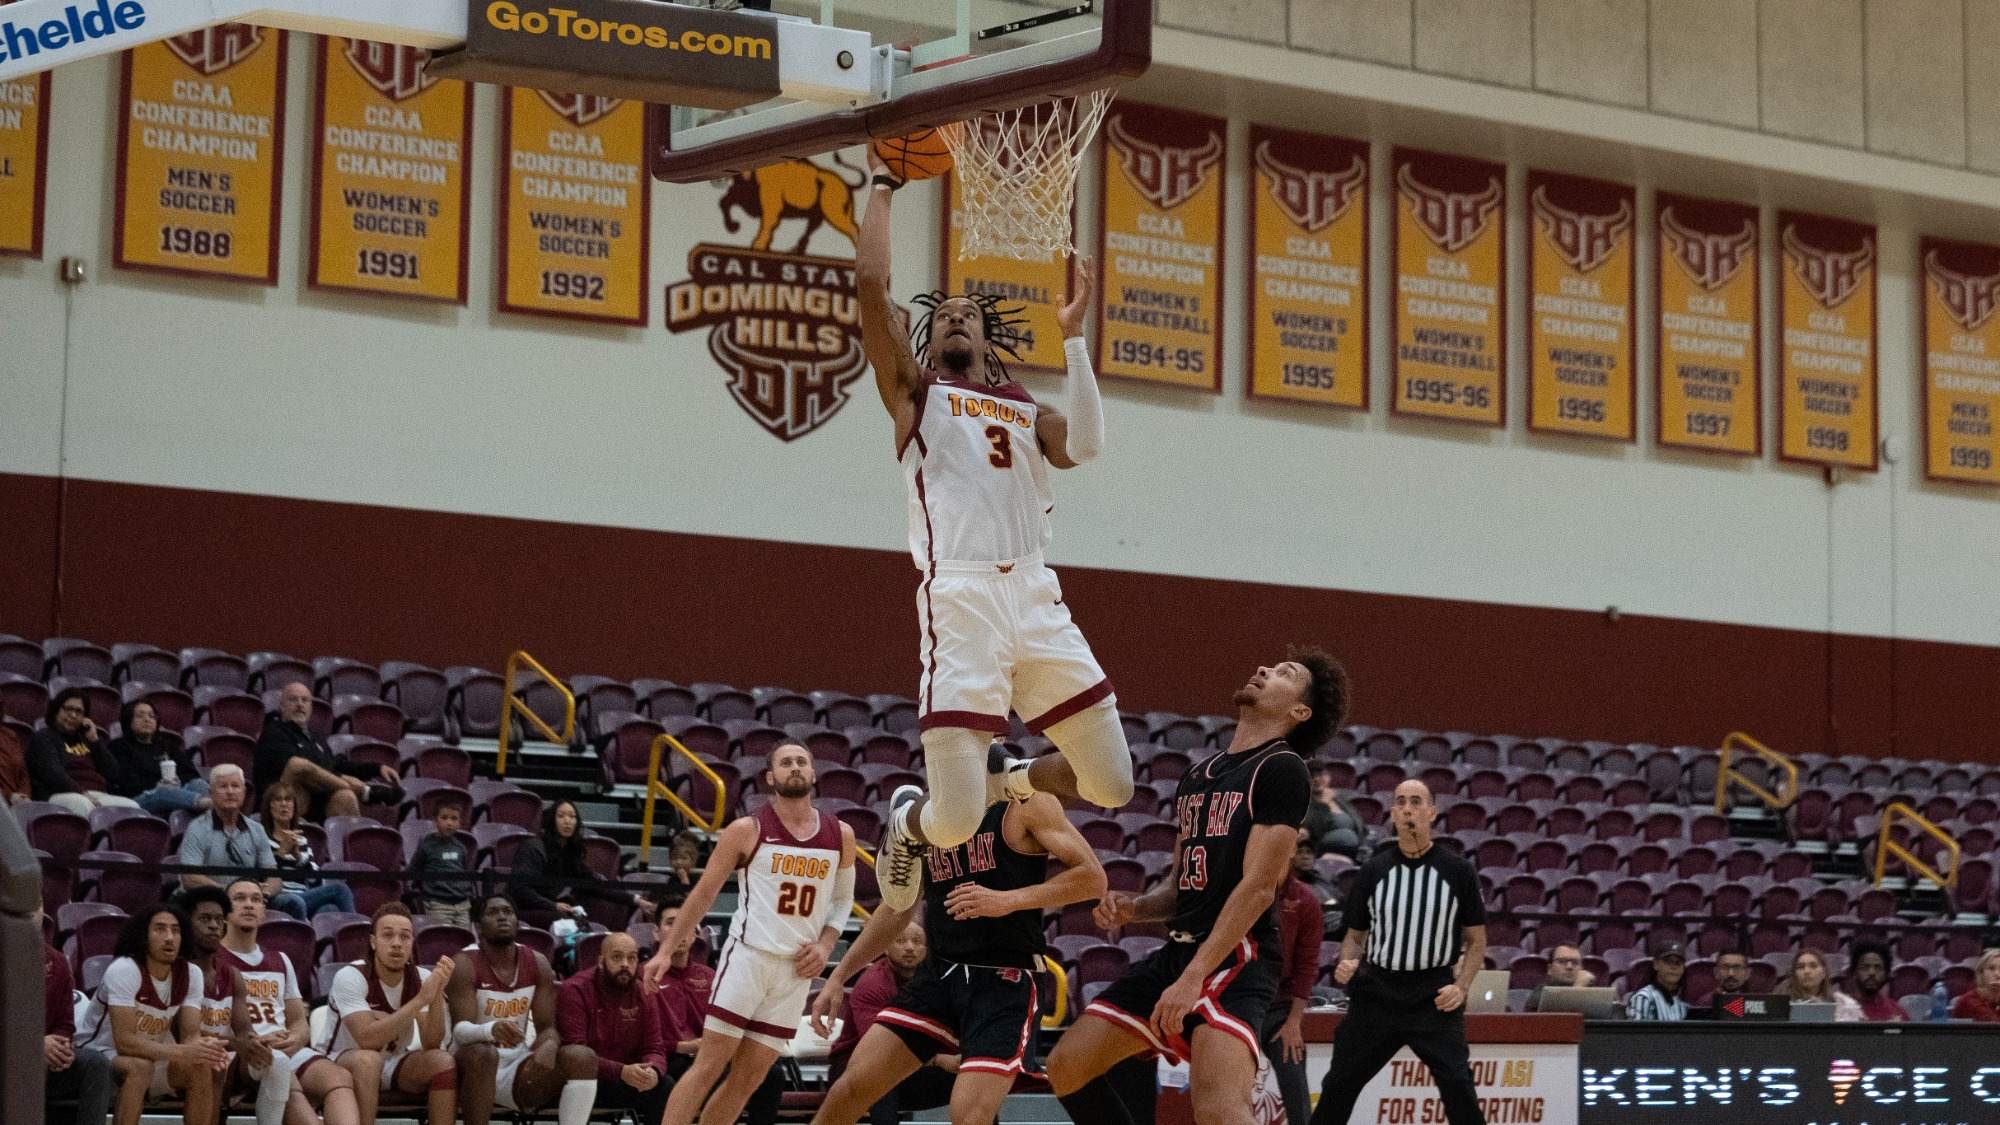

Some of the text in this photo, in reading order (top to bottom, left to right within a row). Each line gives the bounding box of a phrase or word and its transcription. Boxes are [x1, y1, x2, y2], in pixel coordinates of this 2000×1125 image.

[0, 0, 146, 63] helde
[486, 0, 772, 60] GoToros.com
[172, 79, 232, 107] CCAA
[132, 100, 271, 137] CONFERENCE
[365, 104, 422, 130] CCAA
[142, 126, 258, 162] CHAMPION
[325, 125, 458, 162] CONFERENCE
[548, 130, 603, 157] CCAA
[167, 166, 231, 192] MEN'S
[336, 152, 447, 186] CHAMPION
[511, 150, 638, 185] CONFERENCE
[159, 189, 236, 216] SOCCER
[342, 188, 440, 218] WOMEN'S
[522, 176, 627, 208] CHAMPION
[353, 212, 428, 239] SOCCER
[529, 210, 622, 239] WOMEN'S
[1138, 213, 1184, 238] CCAA
[160, 225, 231, 258] 1988
[539, 234, 609, 260] SOCCER
[1106, 231, 1215, 265] CONFERENCE
[1286, 237, 1331, 259] CCAA
[357, 248, 419, 280] 1991
[701, 255, 856, 287] CAL STAT
[1115, 256, 1205, 285] CHAMPION
[1256, 255, 1359, 285] CONFERENCE
[1427, 257, 1469, 279] CCAA
[541, 270, 605, 301] 1992
[1122, 286, 1199, 313] WOMEN'S
[1266, 279, 1350, 305] CHAMPION
[1399, 275, 1496, 304] CONFERENCE
[669, 283, 860, 324] DOMINGU
[1408, 298, 1489, 324] CHAMPION
[1534, 295, 1626, 323] CONFERENCE
[1106, 305, 1210, 335] BASKETBALL
[1272, 310, 1347, 335] WOMEN'S
[1541, 317, 1619, 343] CHAMPION
[1663, 312, 1752, 340] CONFERENCE
[735, 317, 842, 354] HILLS
[1280, 330, 1338, 353] SOCCER
[1413, 328, 1485, 351] WOMEN'S
[1669, 334, 1745, 358] CHAMPION
[1111, 339, 1205, 374] 1994-95
[1400, 346, 1496, 372] BASKETBALL
[1549, 348, 1615, 371] WOMEN'S
[1791, 350, 1862, 375] CHAMPION
[1281, 362, 1335, 390] 1995
[1555, 367, 1608, 388] SOCCER
[1405, 378, 1490, 409] 1995-96
[1684, 382, 1733, 403] SOCCER
[947, 393, 1031, 429] TOROS
[1558, 397, 1605, 423] 1996
[1686, 412, 1731, 437] 1997
[1806, 426, 1849, 451] 1998
[984, 423, 1013, 470] 3
[1950, 447, 1991, 470] 1999
[1206, 791, 1243, 837] BAY
[771, 853, 831, 879] TOROS
[927, 832, 997, 883] EAST BAY
[1179, 845, 1208, 891] 13
[777, 881, 817, 918] 20
[244, 979, 279, 999] ROS
[1390, 1060, 1534, 1087] THA OU ASI
[1583, 1067, 1800, 1106] KEN'S
[1377, 1098, 1416, 1125] FOR
